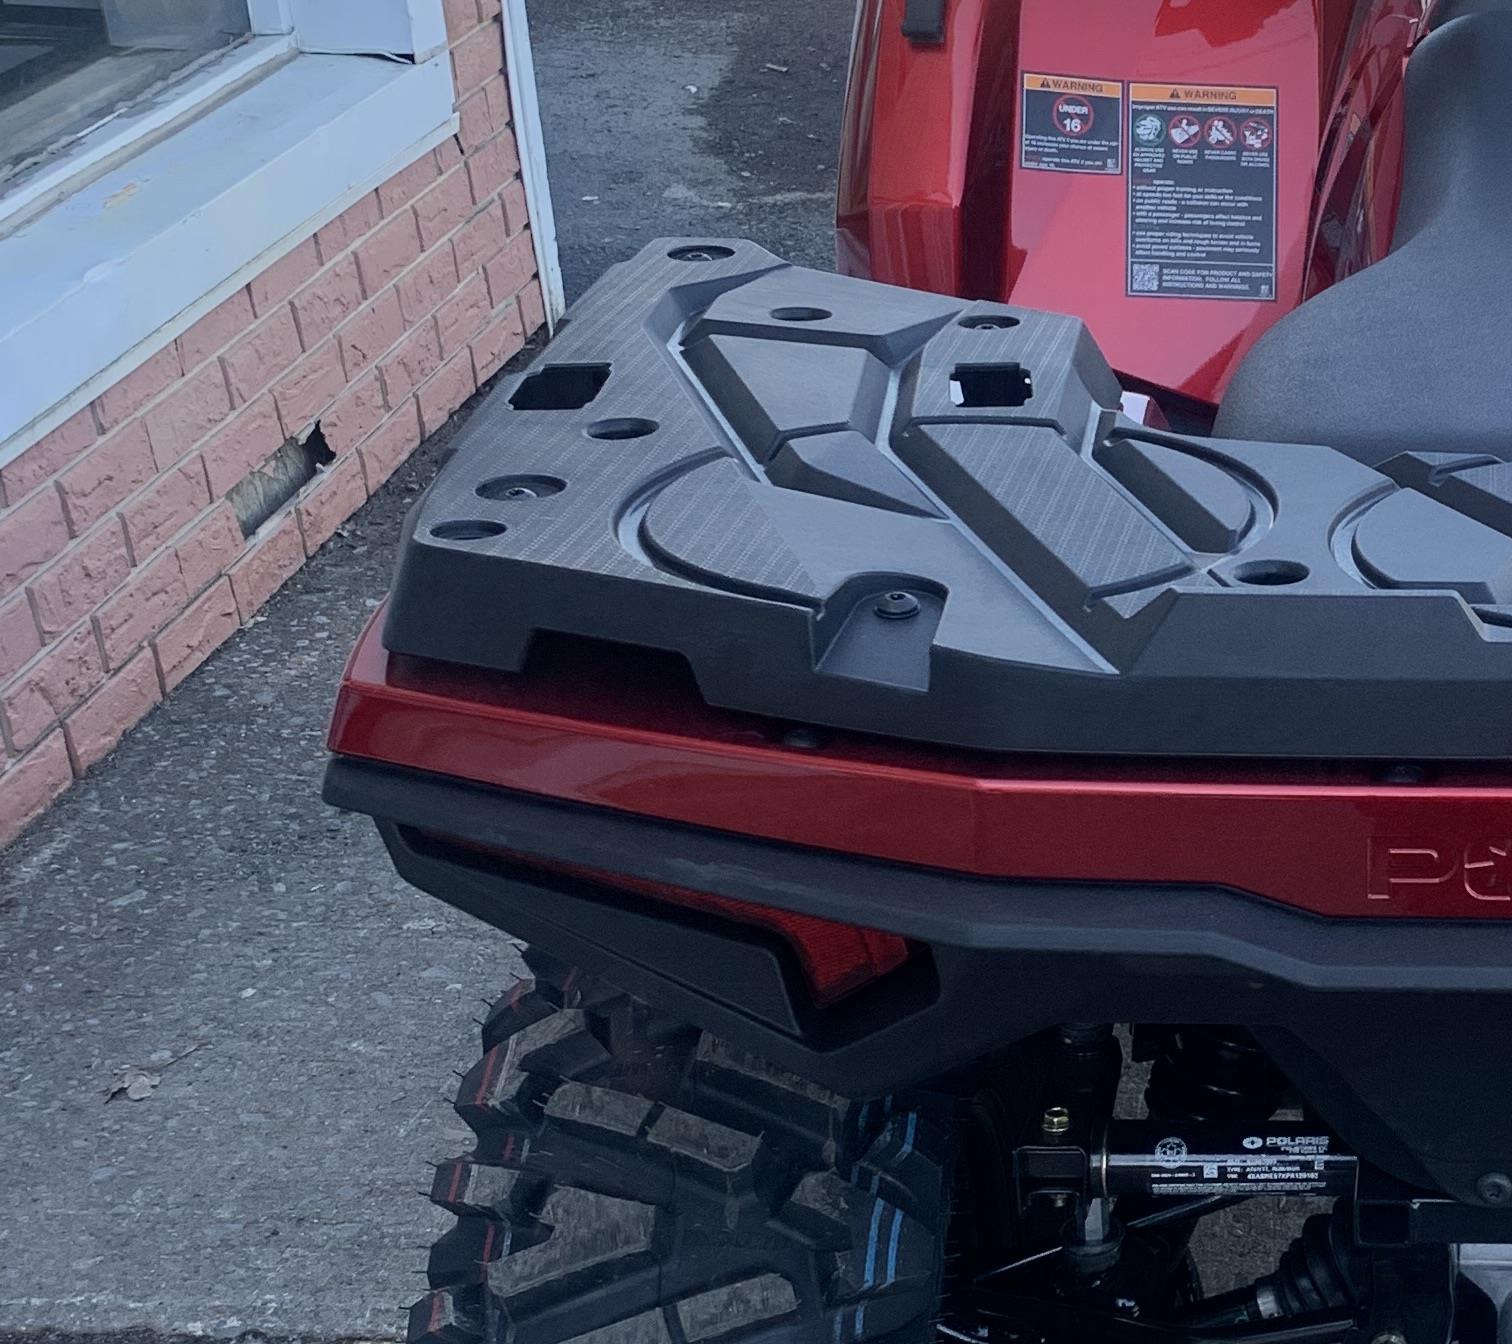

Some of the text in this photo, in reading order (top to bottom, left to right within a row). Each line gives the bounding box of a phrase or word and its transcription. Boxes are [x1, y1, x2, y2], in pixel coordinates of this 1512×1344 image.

[1052, 79, 1104, 92] WARNING
[1184, 89, 1237, 100] WARNING
[1059, 104, 1088, 114] UNDER
[1063, 118, 1080, 132] 16
[1266, 1136, 1329, 1146] POLARIS
